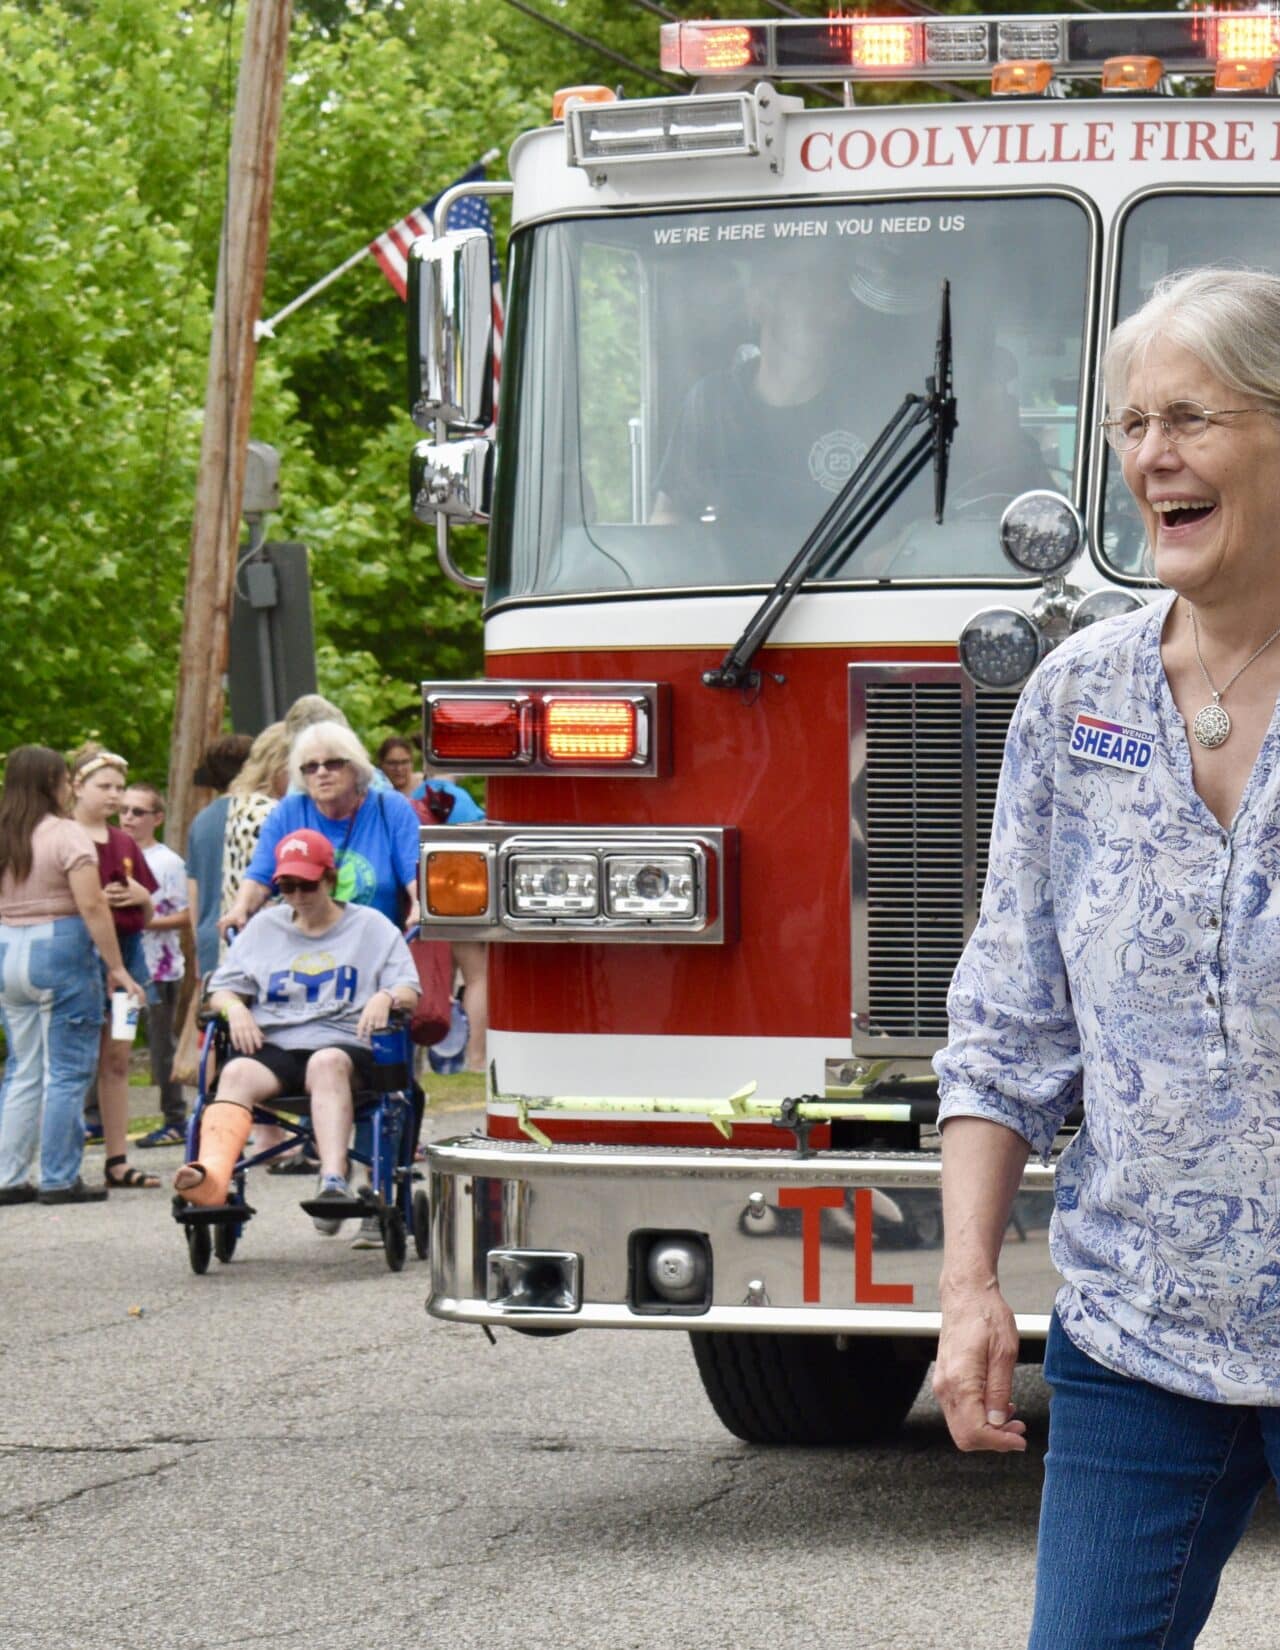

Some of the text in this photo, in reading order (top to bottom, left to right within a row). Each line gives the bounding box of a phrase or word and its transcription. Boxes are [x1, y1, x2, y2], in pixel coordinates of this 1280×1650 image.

[799, 122, 1115, 172] COOLVILLE
[1129, 121, 1255, 161] FIRE
[653, 214, 965, 245] WE'RE HERE WHEN YOU NEED US
[1072, 726, 1151, 768] SHEARD
[1121, 728, 1153, 741] WENDA
[267, 964, 358, 1003] ETH
